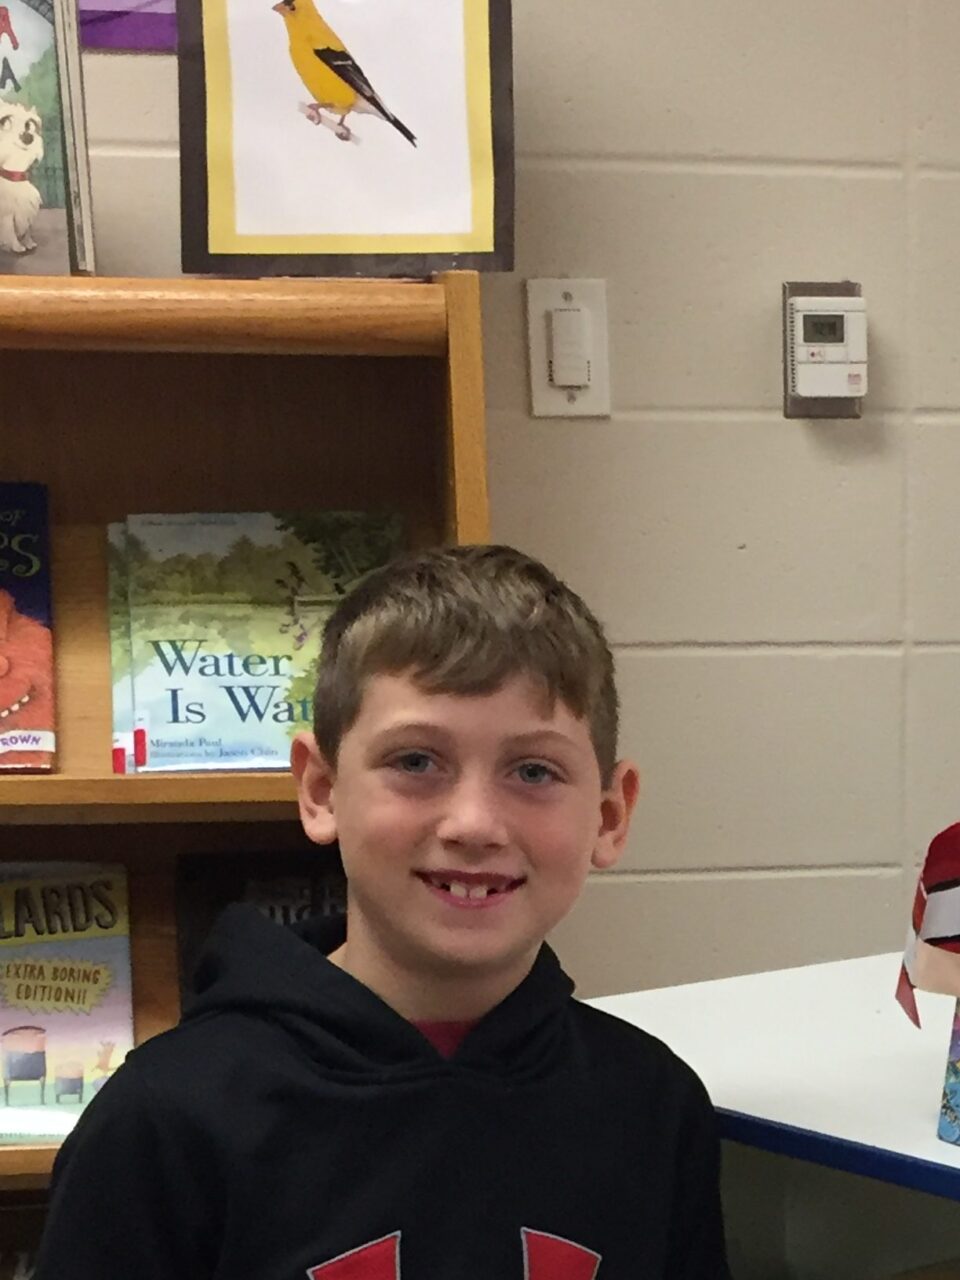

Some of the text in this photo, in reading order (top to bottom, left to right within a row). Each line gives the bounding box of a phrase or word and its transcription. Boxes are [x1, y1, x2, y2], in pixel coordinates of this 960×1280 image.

[147, 638, 294, 677] Water
[165, 687, 207, 724] Is
[6, 963, 102, 985] EXTRA BORING
